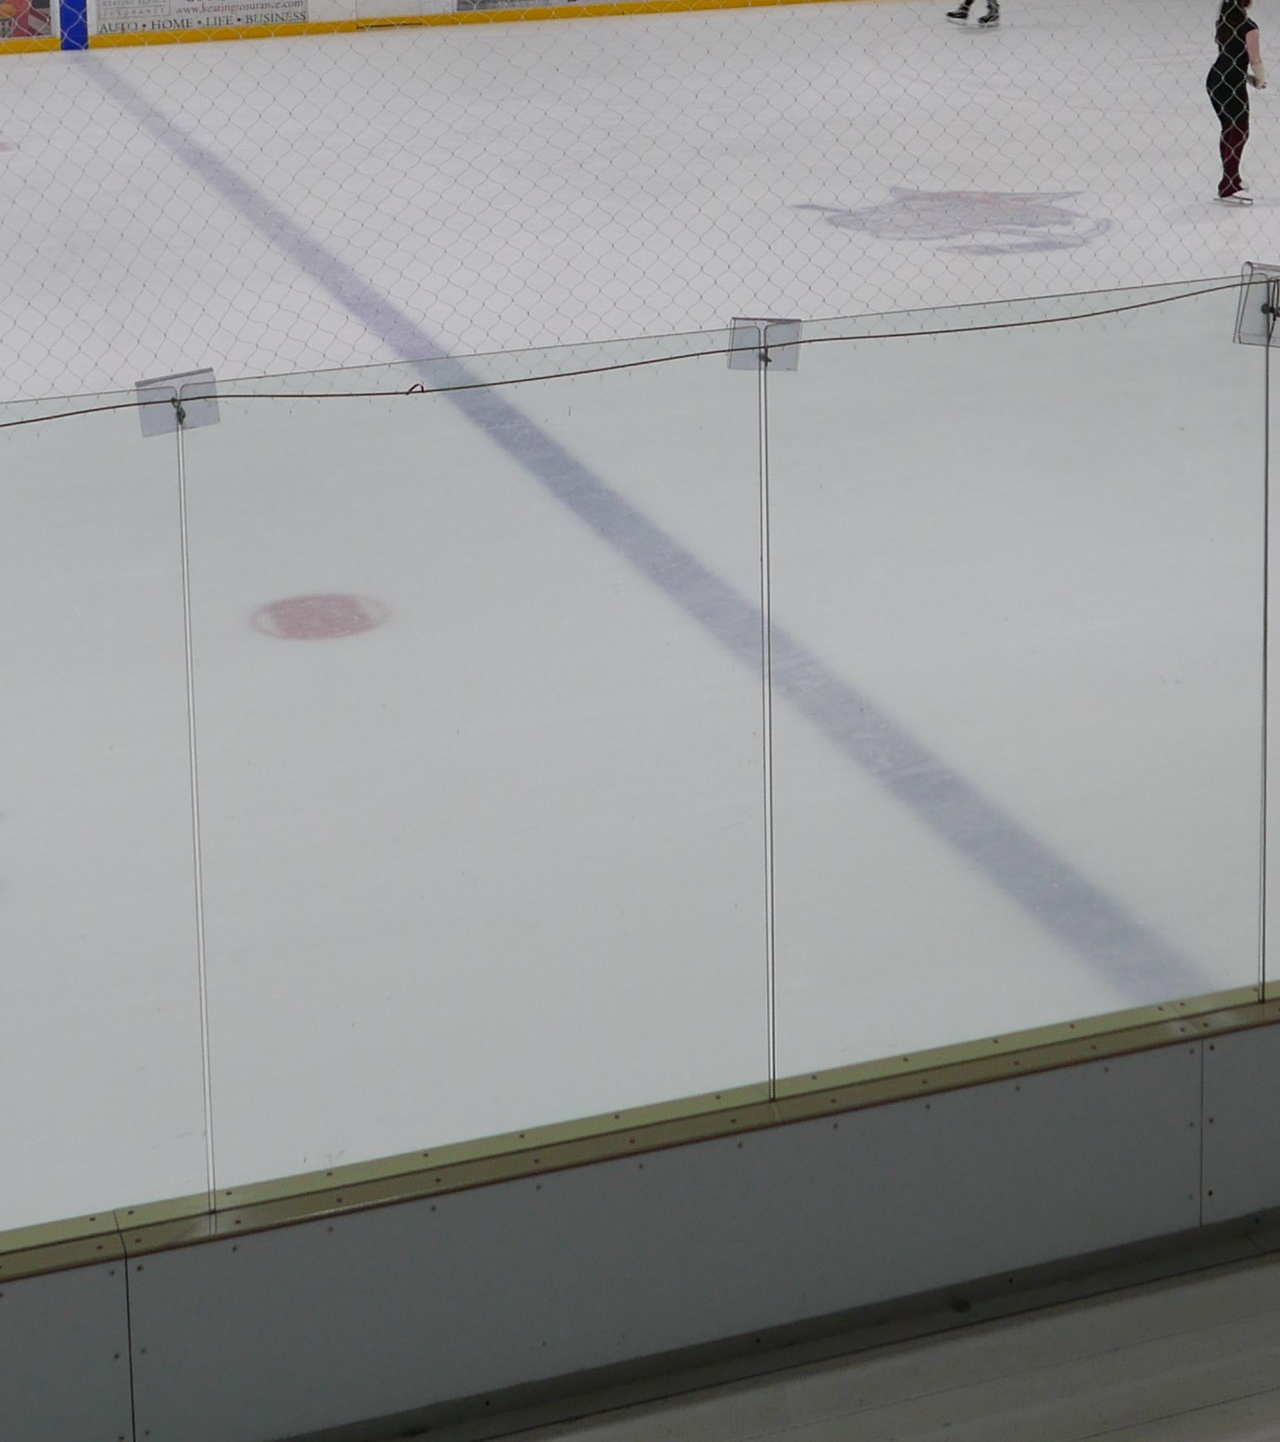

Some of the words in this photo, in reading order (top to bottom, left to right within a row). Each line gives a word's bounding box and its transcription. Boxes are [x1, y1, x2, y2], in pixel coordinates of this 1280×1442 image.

[99, 21, 139, 33] AUTO
[151, 19, 193, 30] HOME
[206, 16, 234, 27] LIFE
[245, 11, 307, 24] BUSINESS
